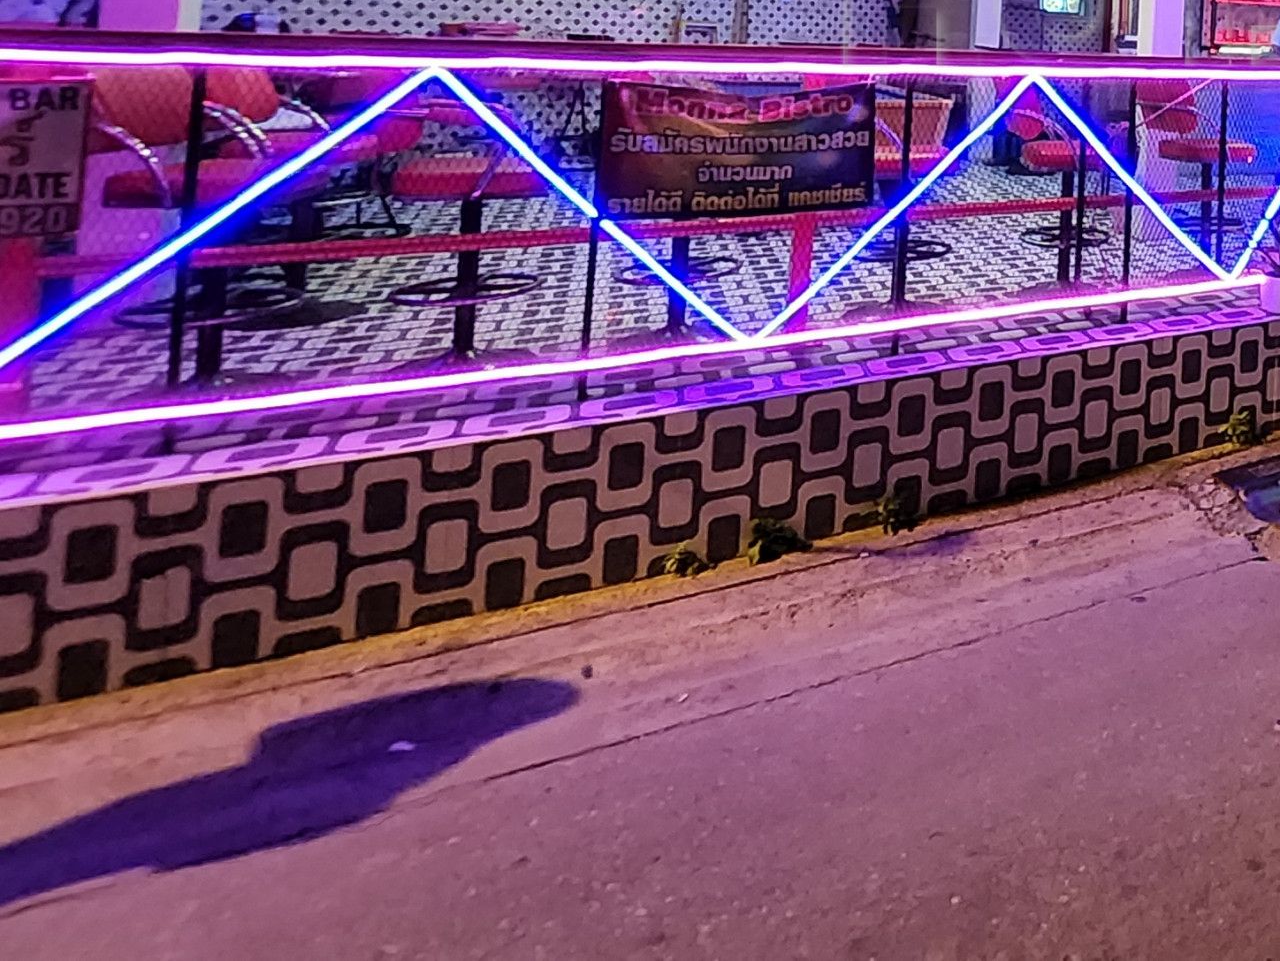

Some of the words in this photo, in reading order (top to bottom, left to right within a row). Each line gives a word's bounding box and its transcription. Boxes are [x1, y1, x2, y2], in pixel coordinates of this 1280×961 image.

[9, 86, 79, 110] BAR
[758, 93, 855, 122] Bistro
[698, 161, 793, 182] จำนวนมาก
[607, 190, 683, 214] รายได้ดี
